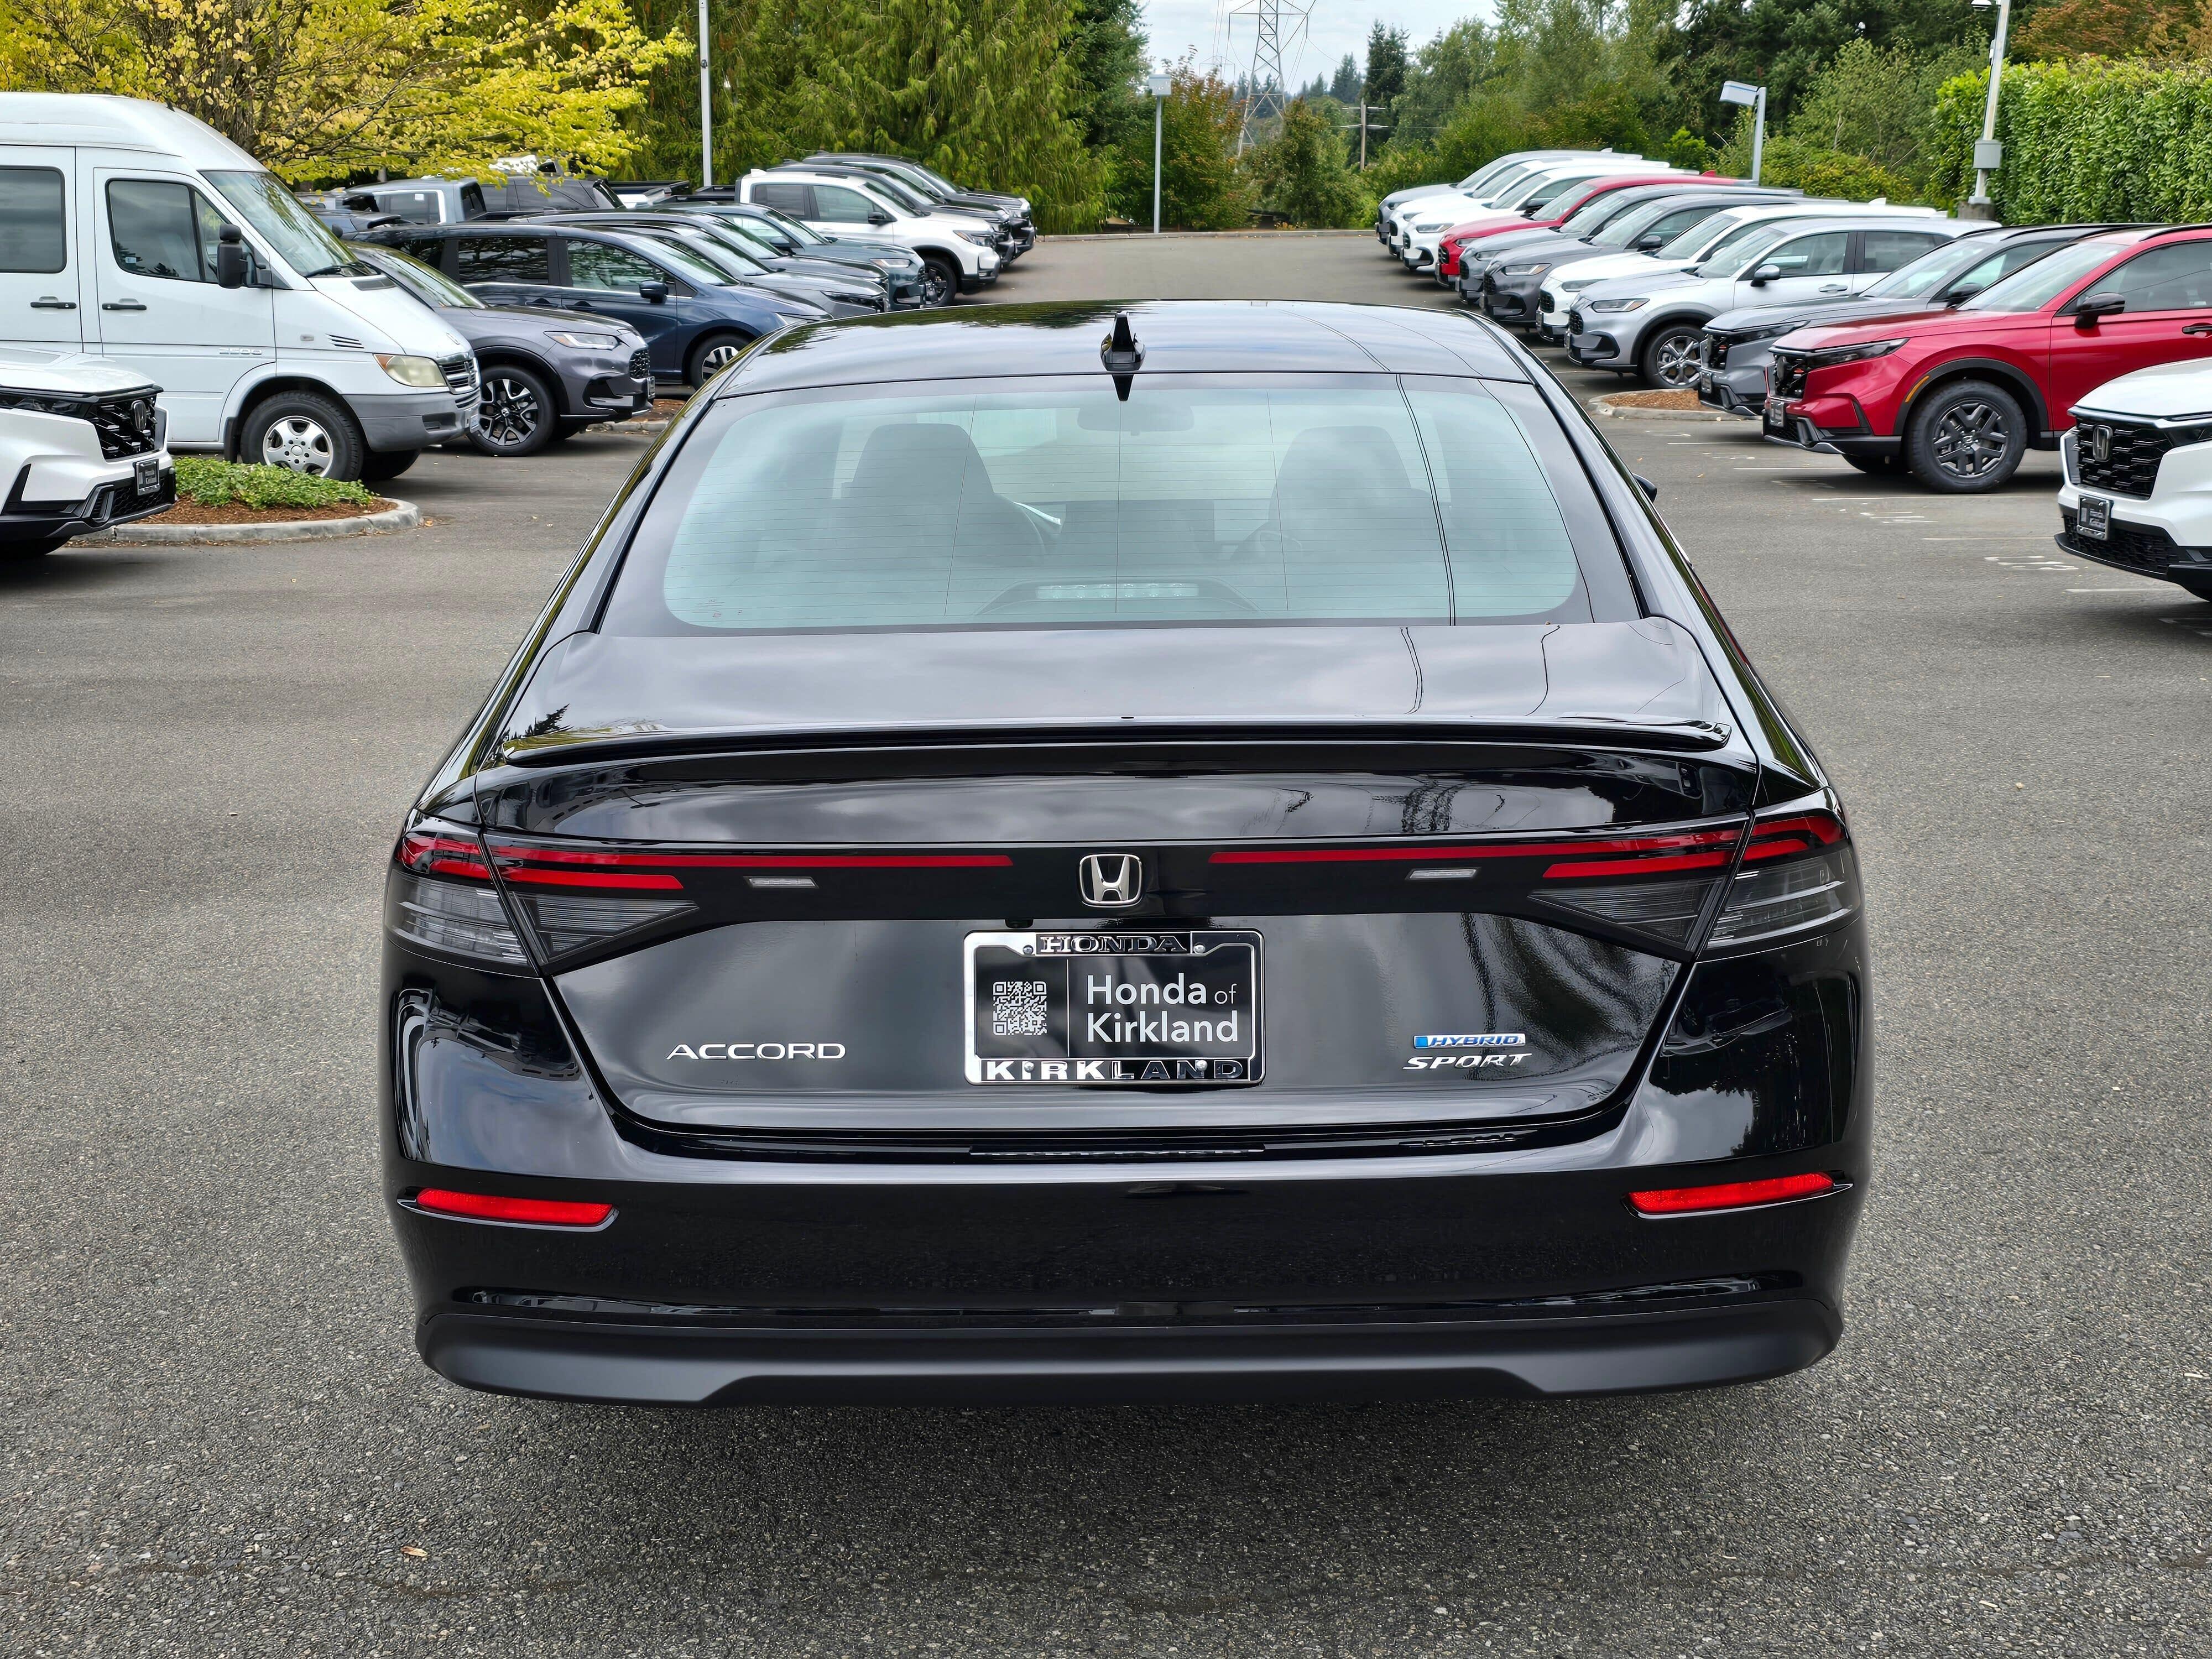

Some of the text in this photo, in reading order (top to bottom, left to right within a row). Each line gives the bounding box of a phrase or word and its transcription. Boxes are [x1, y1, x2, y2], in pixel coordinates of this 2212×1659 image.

[1040, 936, 1187, 953] HONDA
[1087, 972, 1238, 1005] Honda of
[1087, 1010, 1238, 1042] Kirkland
[1430, 1035, 1519, 1047] HYBRID
[666, 1043, 846, 1060] ACCORD
[987, 1060, 1243, 1080] KIRKLAND
[1402, 1053, 1532, 1070] SPORT
